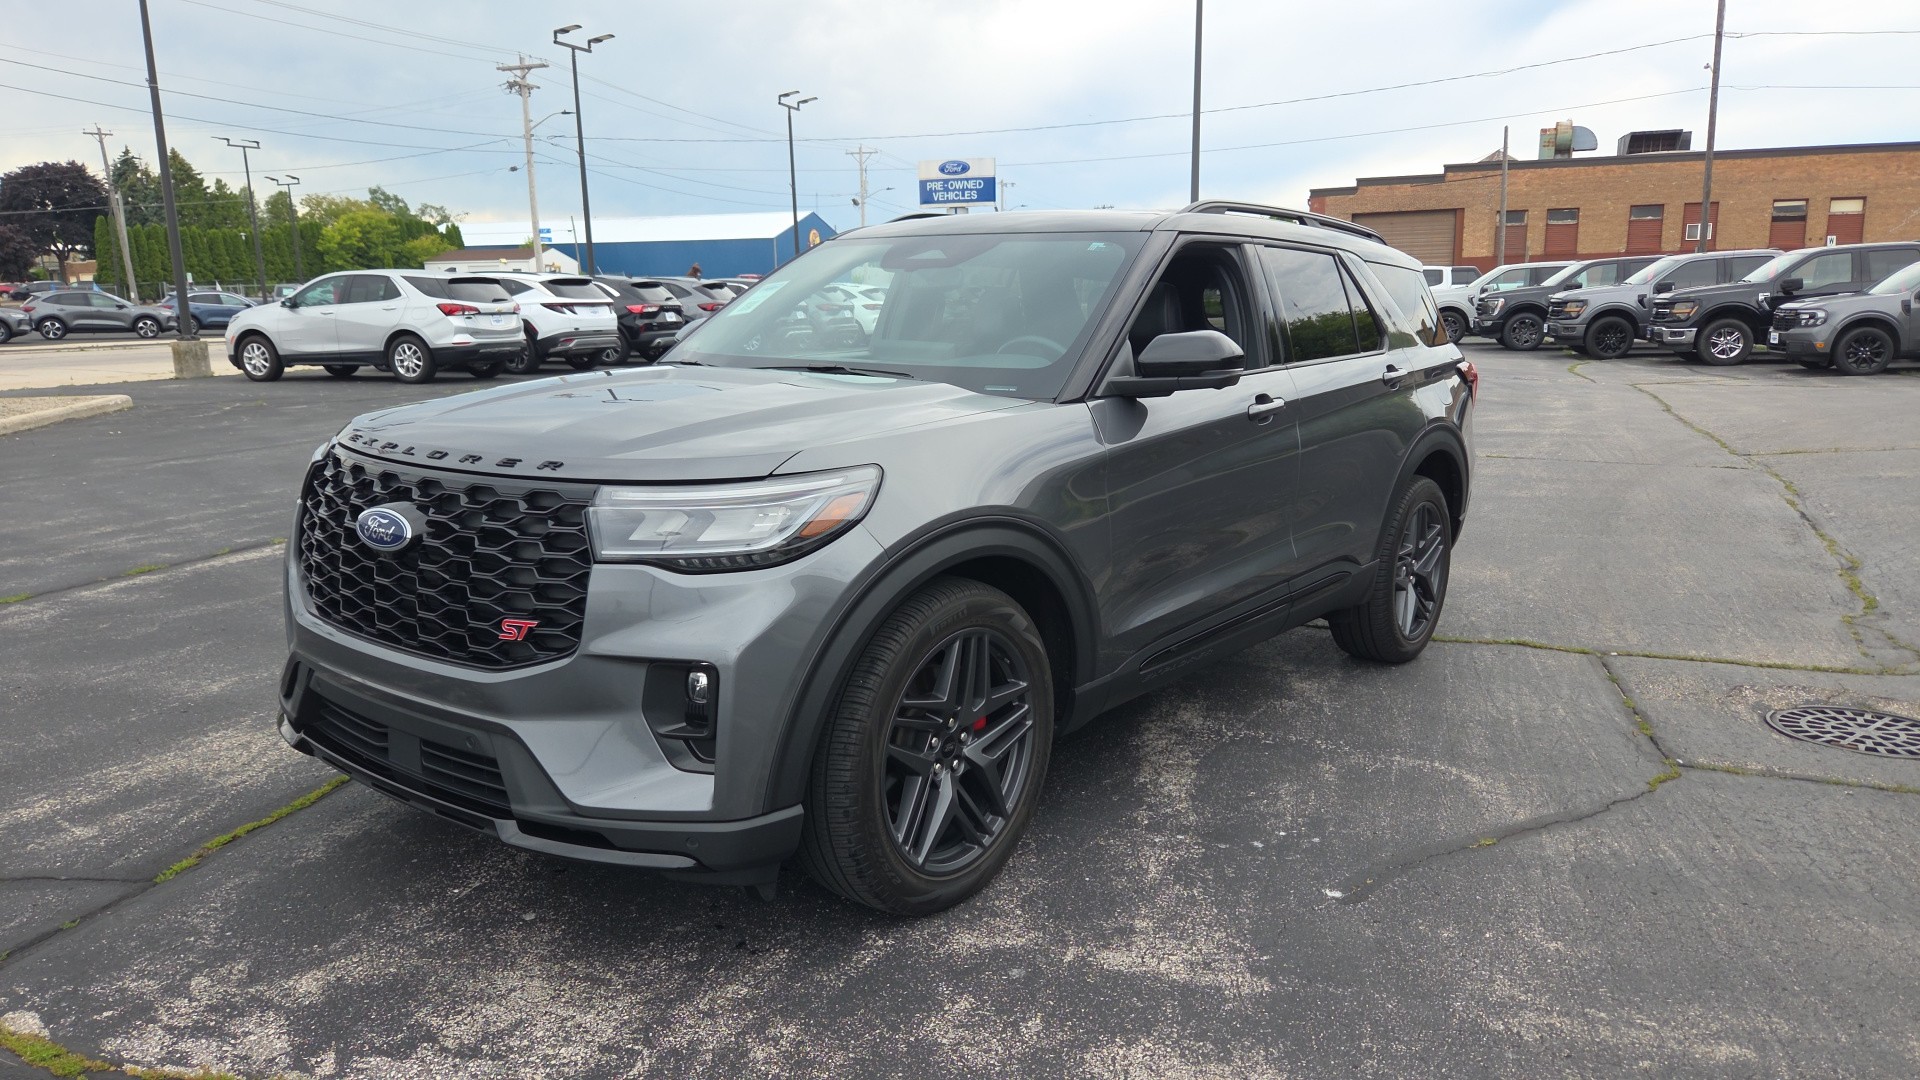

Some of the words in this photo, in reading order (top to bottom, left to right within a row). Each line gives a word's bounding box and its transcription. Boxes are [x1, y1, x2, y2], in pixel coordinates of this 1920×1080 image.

[944, 163, 962, 173] Ford
[932, 190, 978, 201] VEHICLES
[348, 433, 565, 471] EXPLORER
[364, 515, 396, 542] Ford
[498, 618, 538, 641] ST
